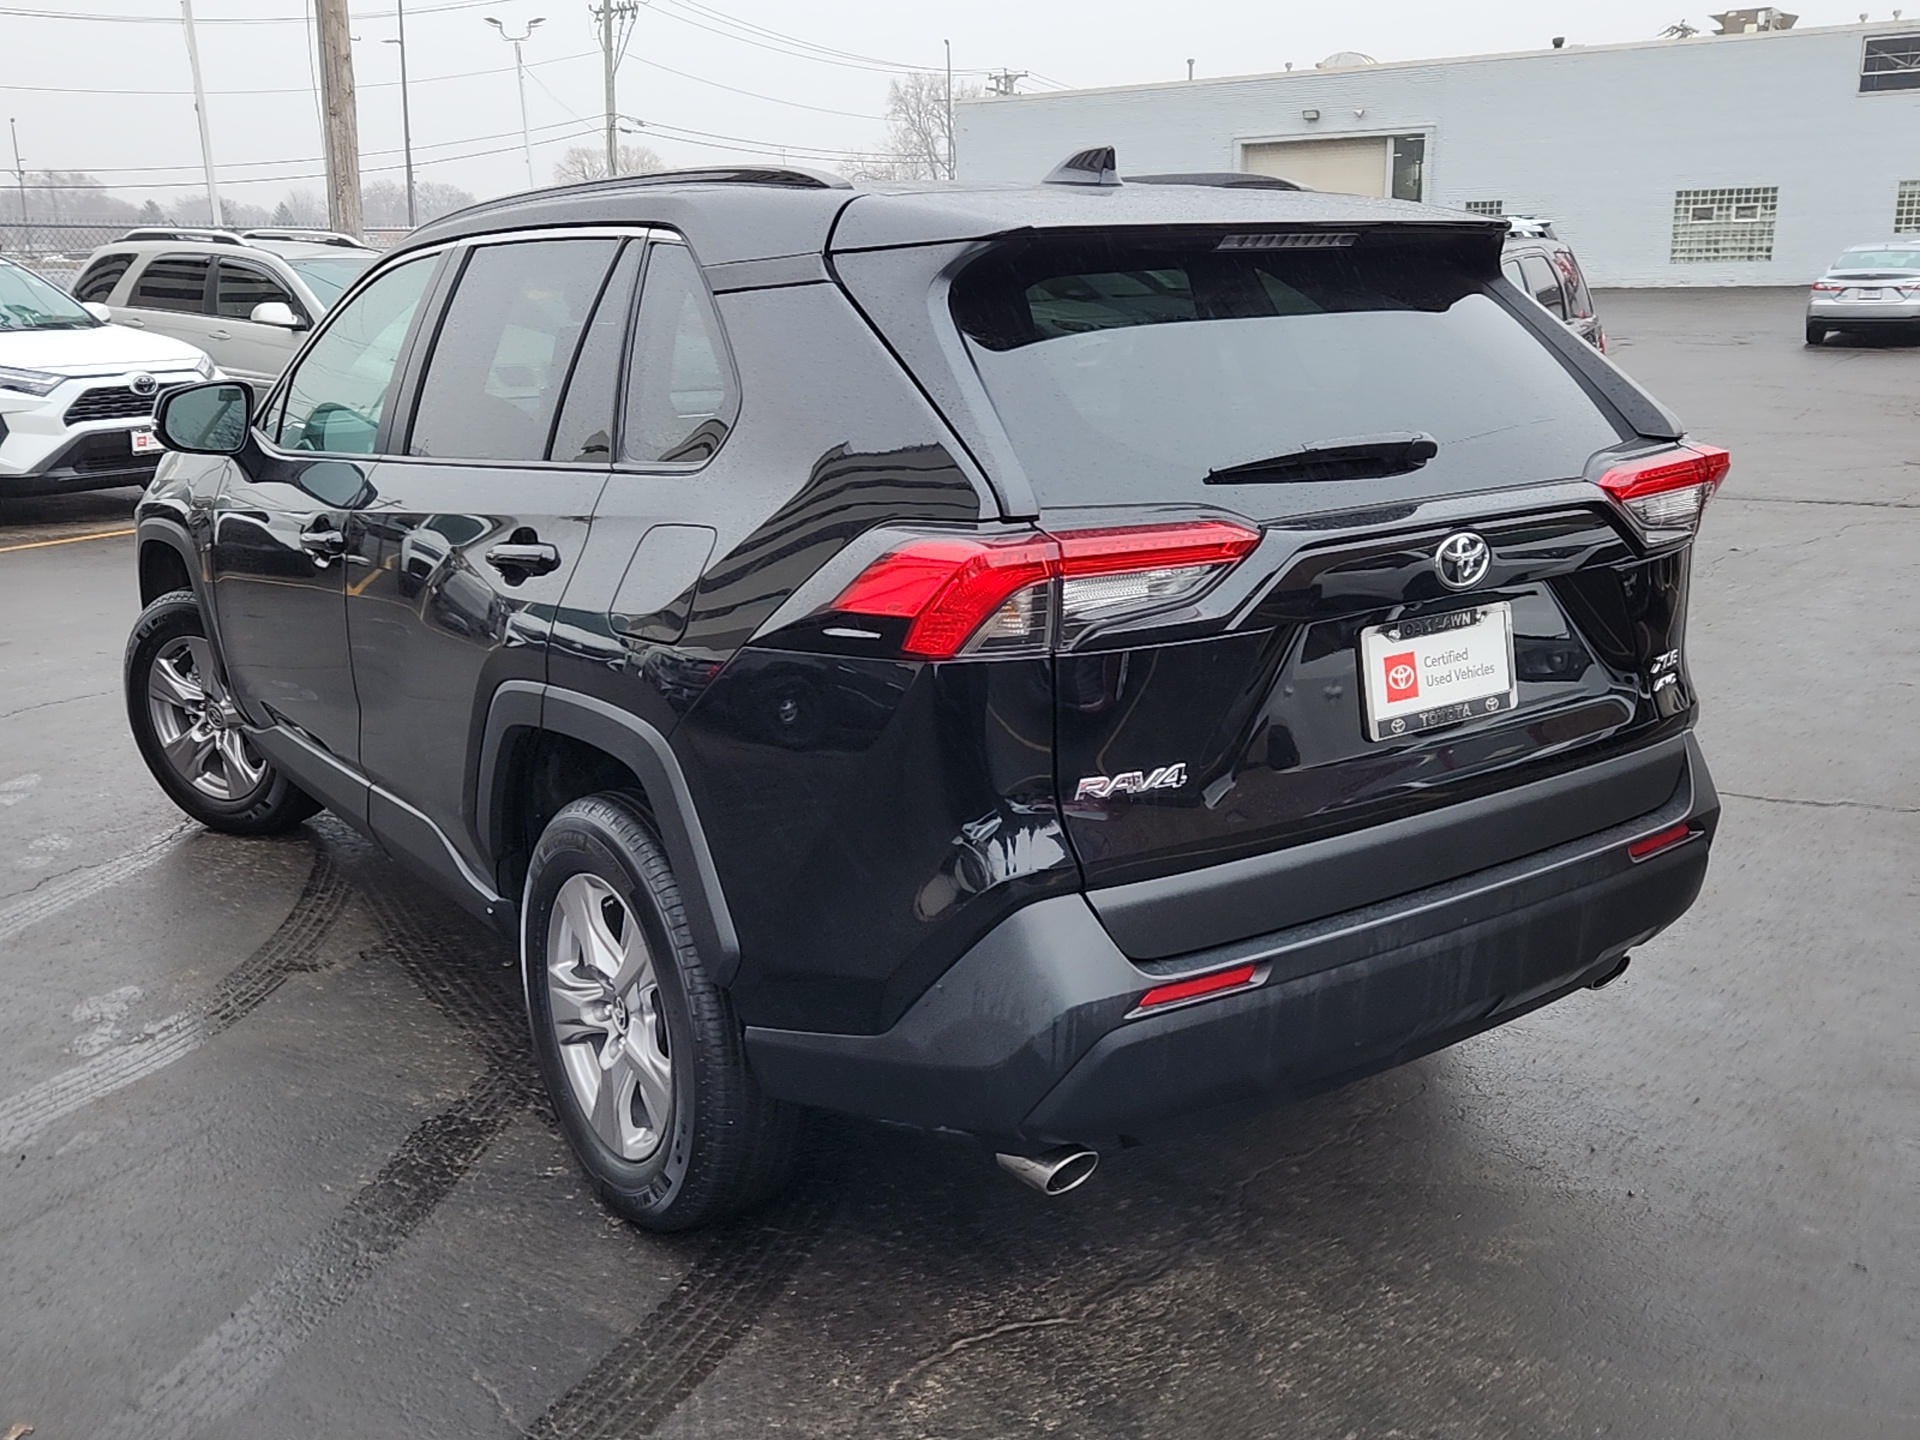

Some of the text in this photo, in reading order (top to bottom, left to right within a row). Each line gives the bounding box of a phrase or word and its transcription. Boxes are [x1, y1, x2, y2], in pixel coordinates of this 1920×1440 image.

[1424, 648, 1469, 668] Certified
[1426, 664, 1495, 687] Used Vehicles
[1419, 703, 1472, 727] TOYOTA
[1074, 763, 1188, 801] RAV4
